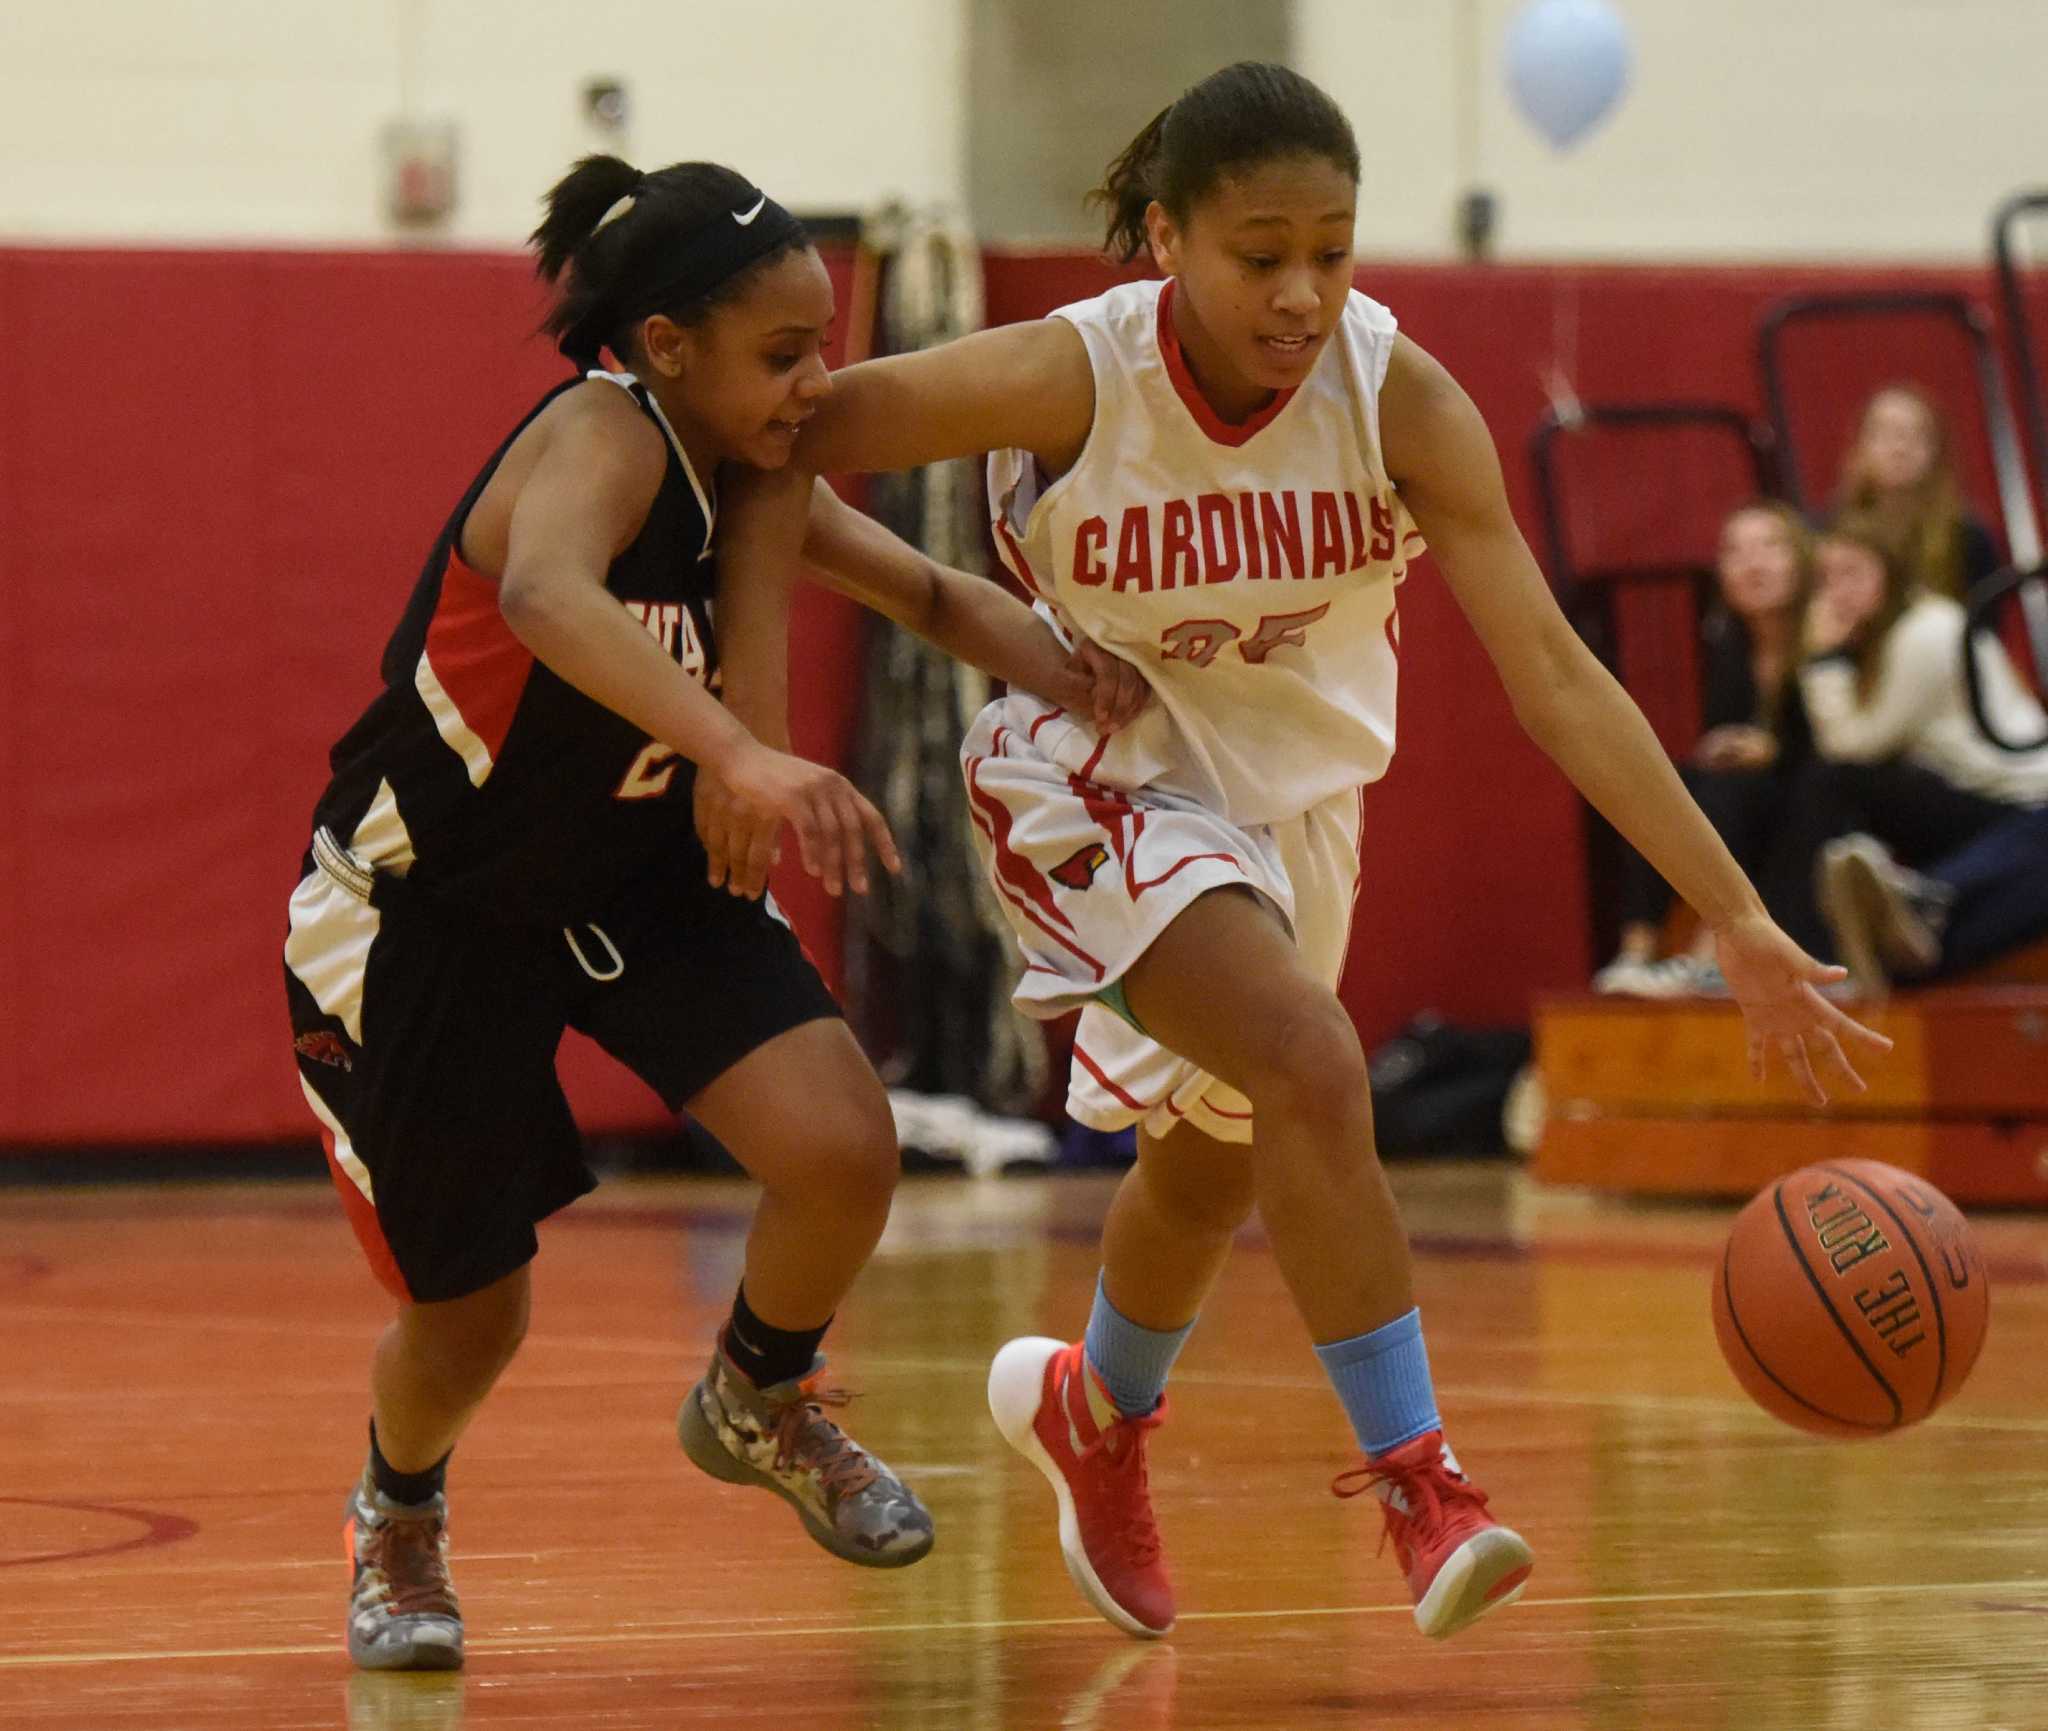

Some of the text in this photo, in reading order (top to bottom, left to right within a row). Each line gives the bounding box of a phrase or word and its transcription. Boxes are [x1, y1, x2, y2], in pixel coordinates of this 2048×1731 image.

[1072, 489, 1396, 594] CARDINALS
[1804, 1182, 1926, 1358] THE ROCK
